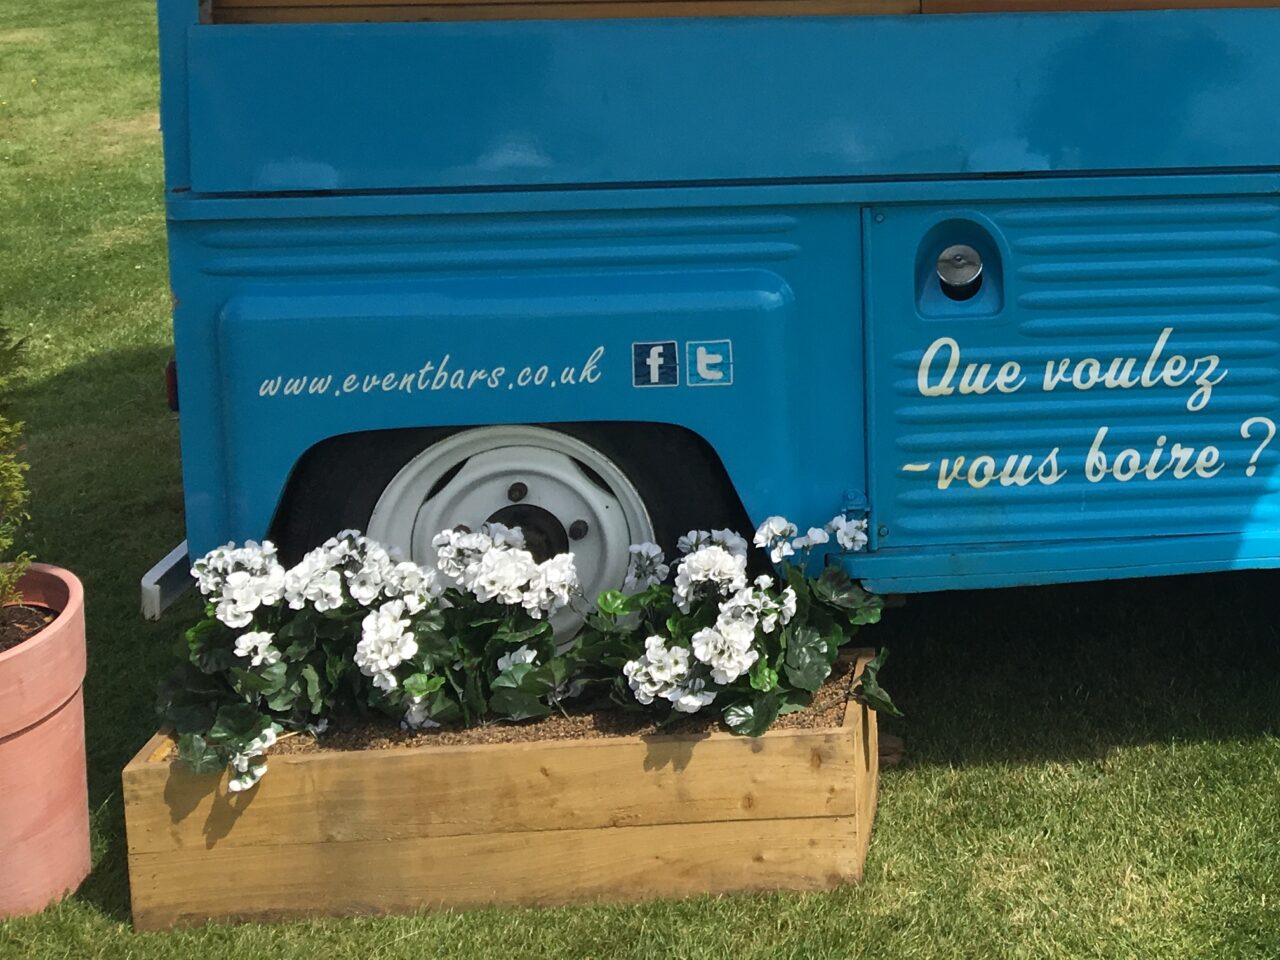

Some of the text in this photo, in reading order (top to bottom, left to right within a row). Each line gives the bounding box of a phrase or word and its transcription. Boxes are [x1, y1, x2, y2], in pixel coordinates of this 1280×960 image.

[259, 346, 605, 397] www.eventbars.co.uk
[917, 327, 1228, 411] Que voulez
